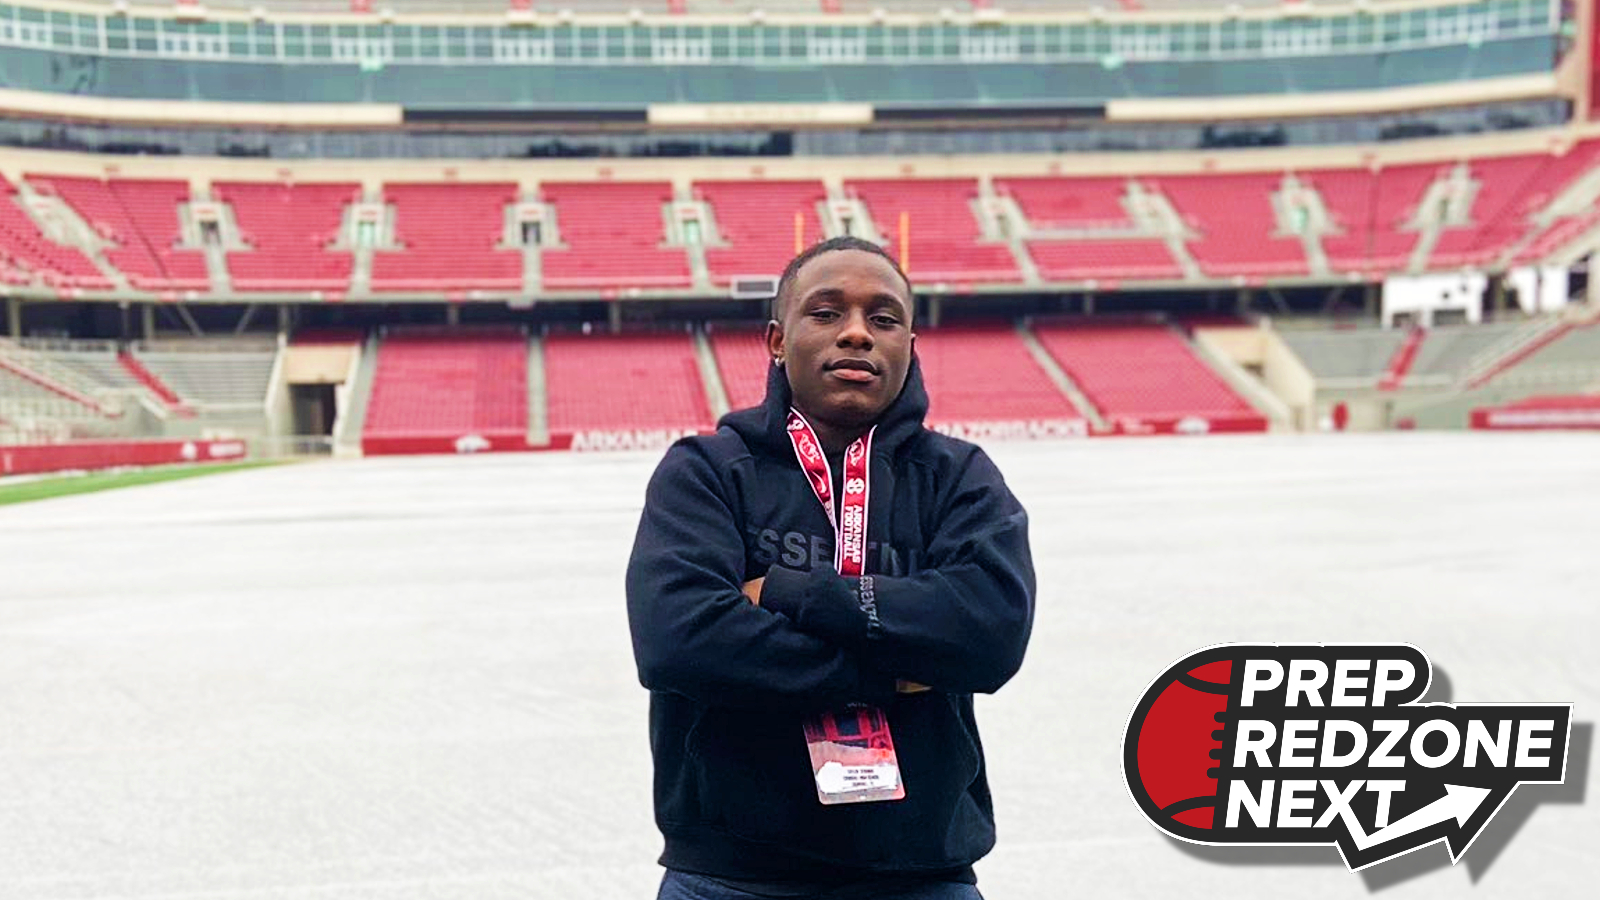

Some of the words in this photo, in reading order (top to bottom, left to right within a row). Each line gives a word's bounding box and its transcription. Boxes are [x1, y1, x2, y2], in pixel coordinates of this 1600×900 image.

[573, 430, 697, 452] ARKANSA
[844, 505, 853, 560] FOOTBALL
[852, 504, 862, 563] ARKANSAS
